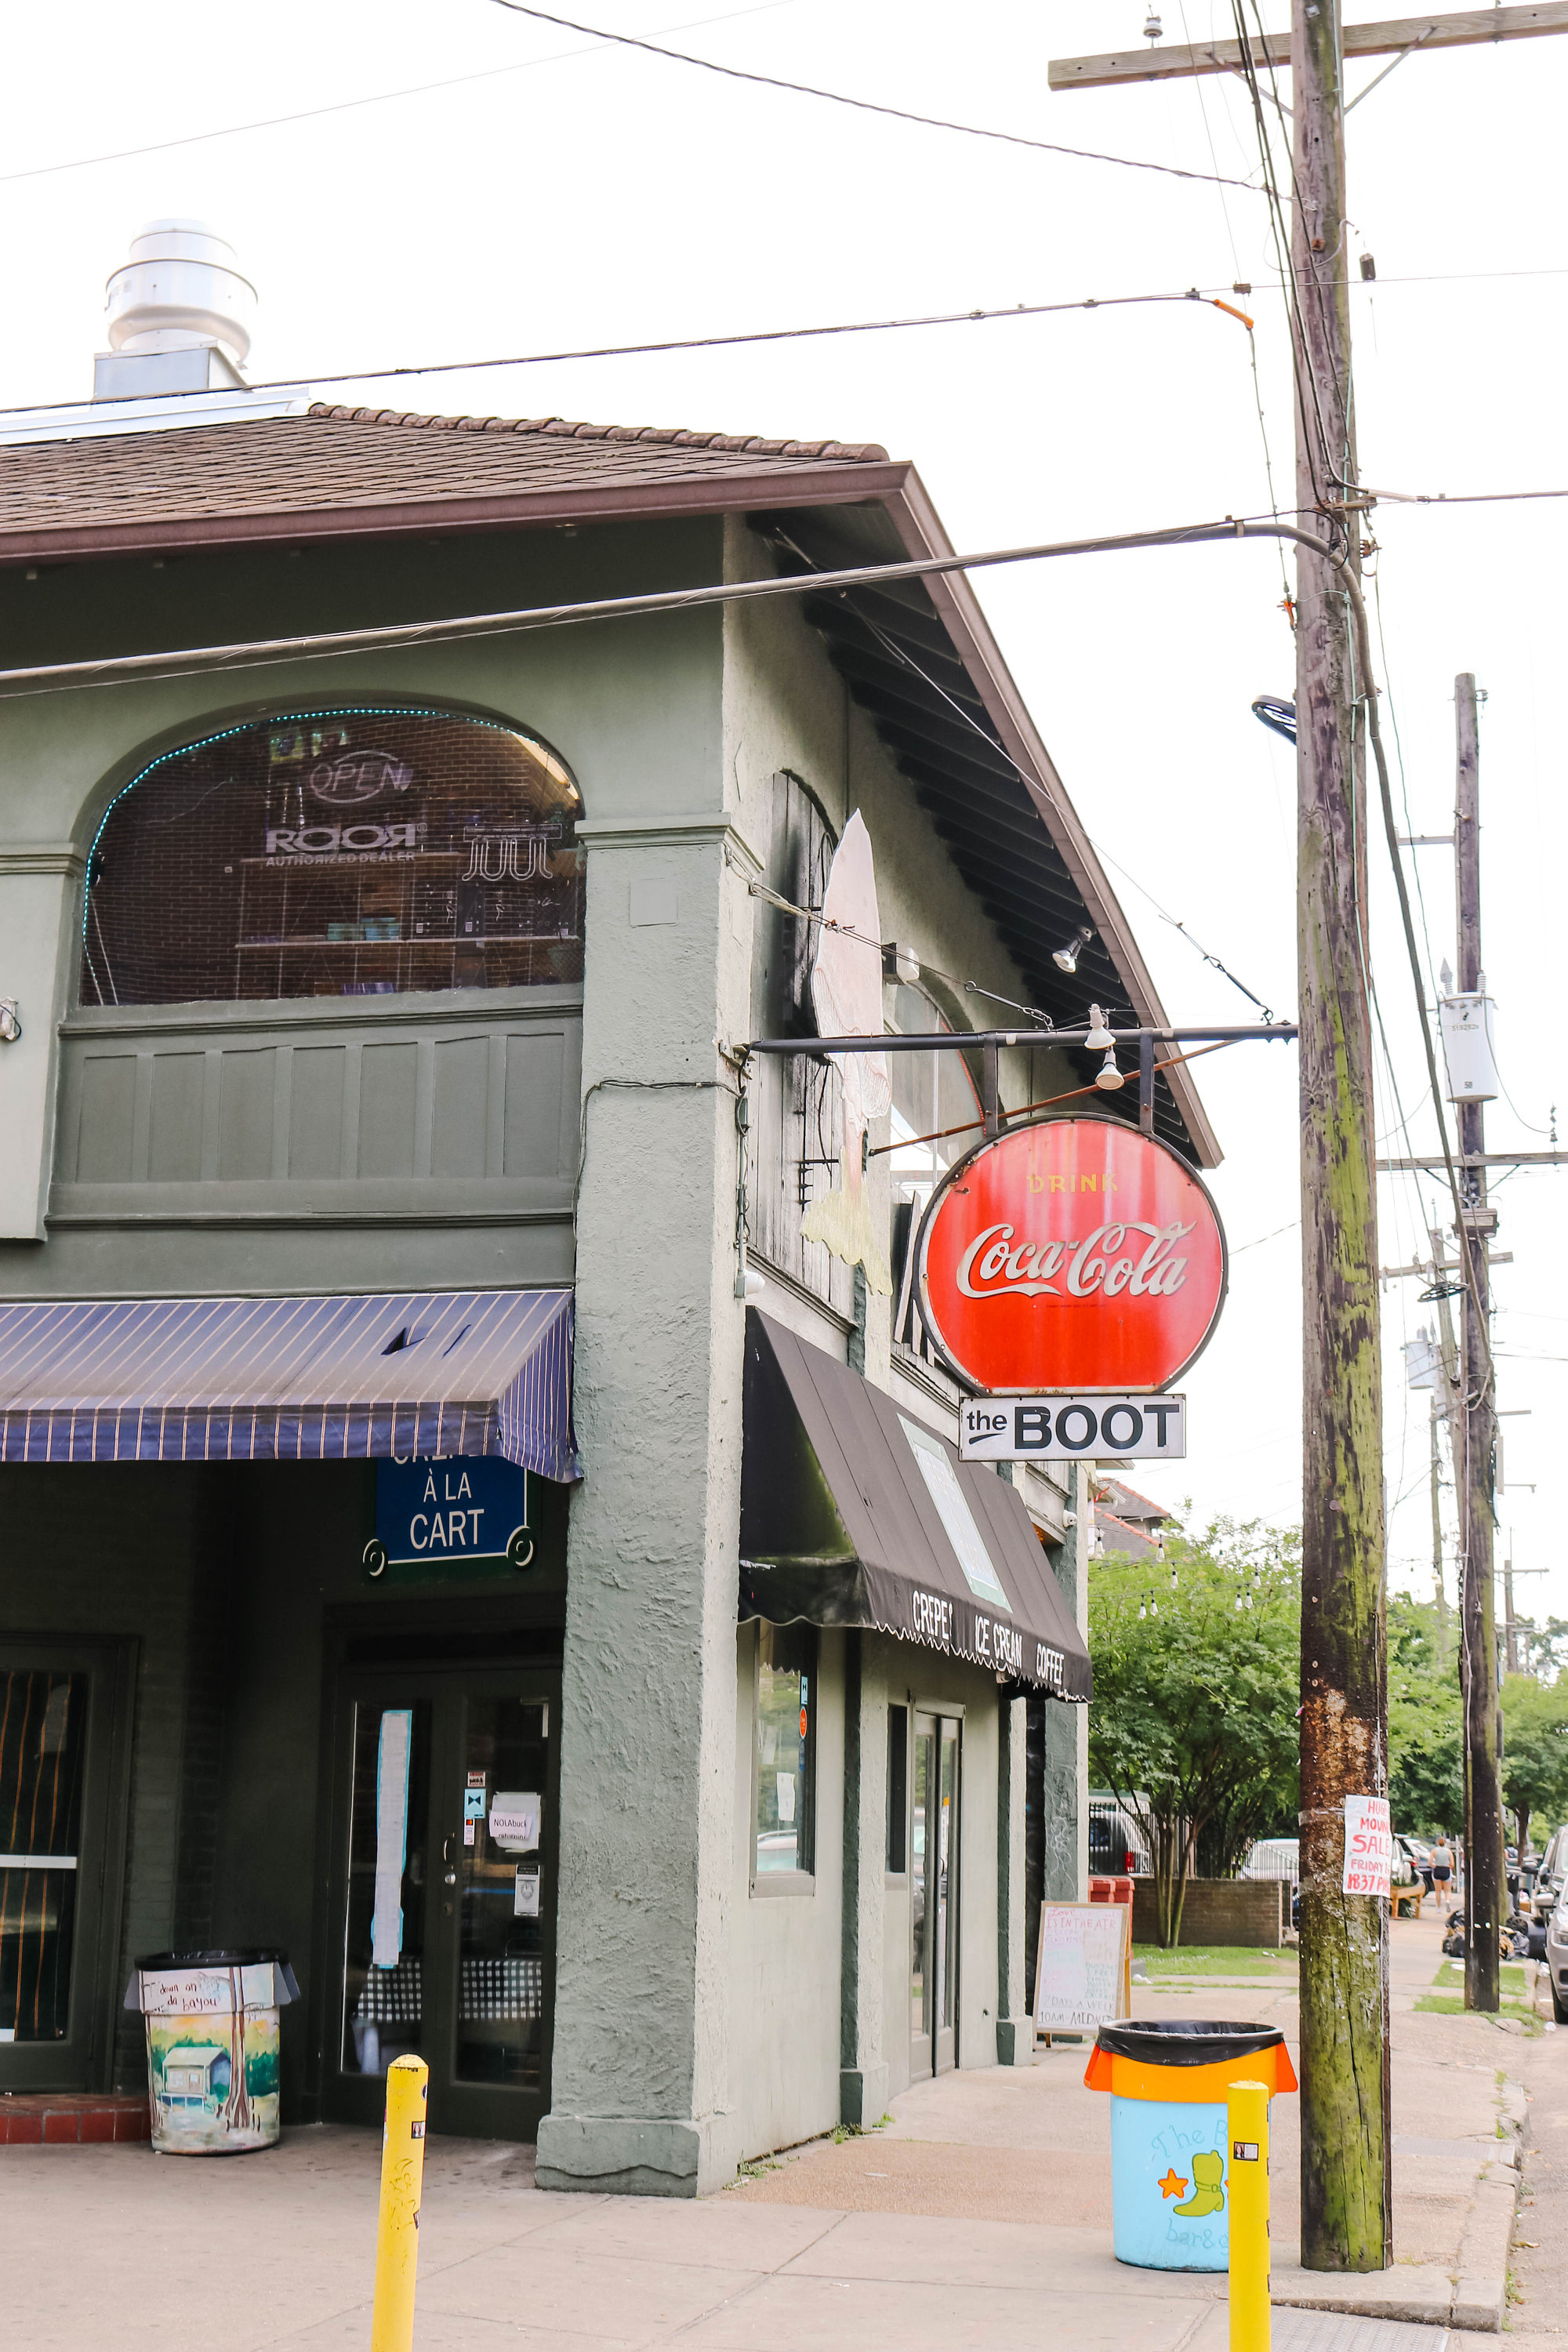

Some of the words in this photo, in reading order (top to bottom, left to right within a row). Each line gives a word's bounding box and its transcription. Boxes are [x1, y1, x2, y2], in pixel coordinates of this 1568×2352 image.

[310, 762, 405, 793] OPEN
[265, 852, 358, 867] AUTHORIZED
[359, 851, 416, 863] DEALER
[1025, 1173, 1119, 1194] DRINK
[956, 1219, 1198, 1298] Coca-Cola
[966, 1410, 1008, 1432] the
[1014, 1403, 1181, 1450] BOOT
[423, 1467, 437, 1503] À
[445, 1472, 473, 1501] LA
[410, 1508, 485, 1550] CART
[975, 1614, 991, 1657] ICE
[1036, 1642, 1065, 1686] COFFEE
[1352, 1834, 1390, 1857] SALE
[1351, 1858, 1384, 1874] FRIDAY
[1347, 1873, 1375, 1892] 1837
[1060, 1918, 1072, 1928] IN
[1073, 1918, 1092, 1929] THE
[1094, 1918, 1116, 1932] AIR
[160, 1983, 179, 1995] down
[186, 1983, 197, 1992] on
[167, 1994, 178, 2006] da
[182, 1998, 217, 2013] bayou
[1051, 1995, 1073, 2008] DAYS
[1151, 2125, 1206, 2158] The
